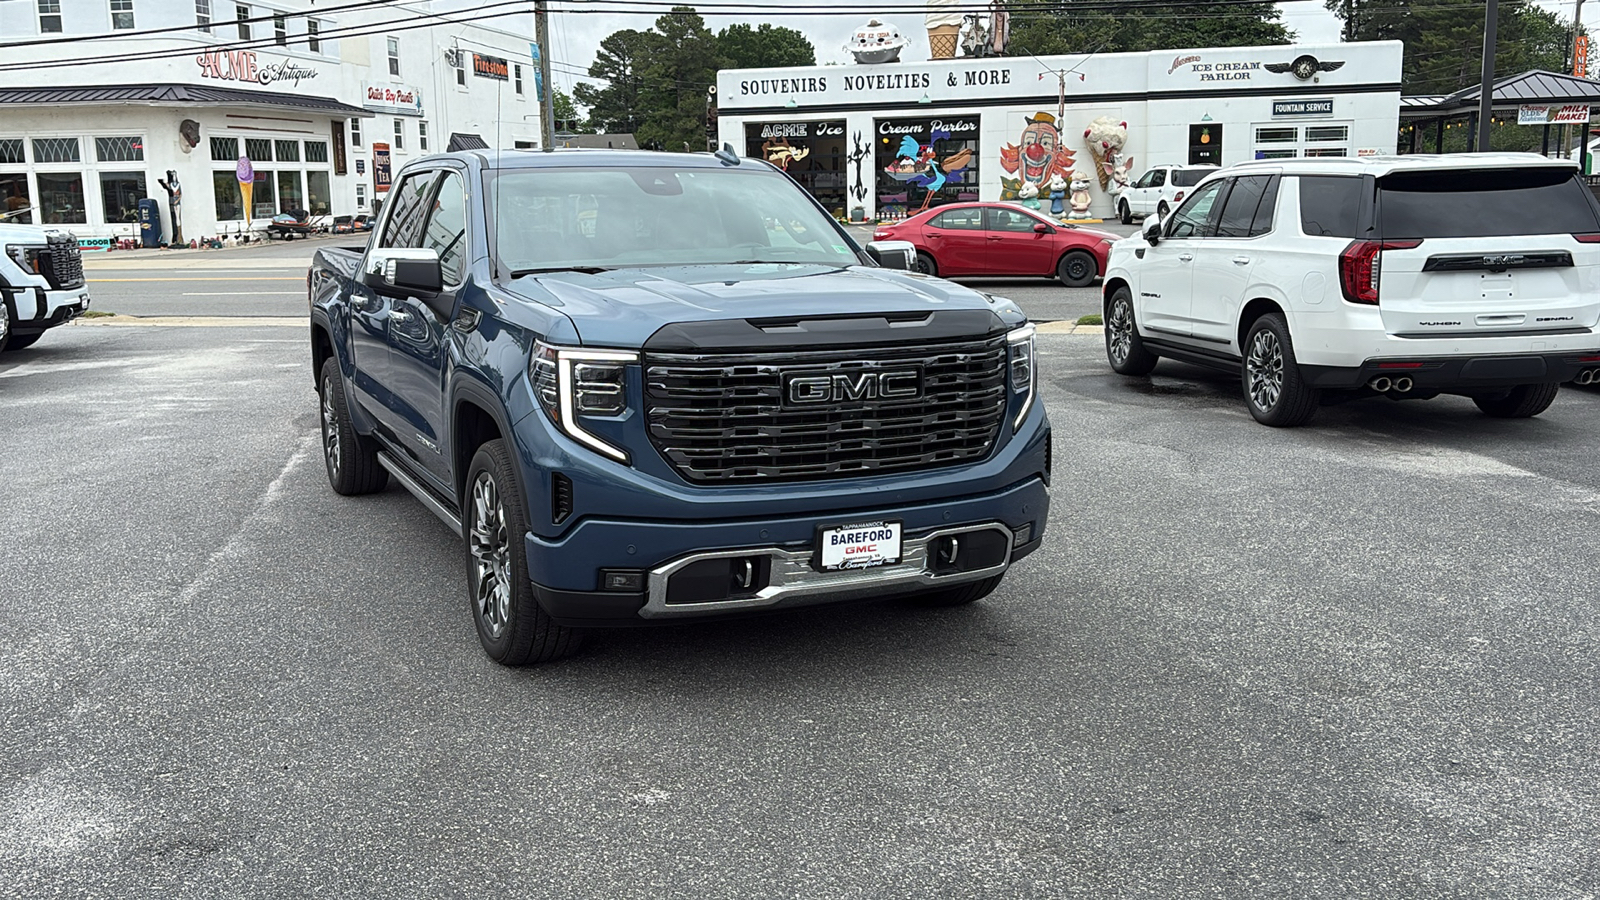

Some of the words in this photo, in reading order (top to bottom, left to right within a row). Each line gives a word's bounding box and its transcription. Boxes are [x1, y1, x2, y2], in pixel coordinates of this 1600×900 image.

[196, 47, 259, 83] ACME
[258, 57, 319, 88] Antiques
[473, 53, 508, 76] Firestone
[1191, 64, 1213, 72] ICE
[1215, 61, 1262, 72] CREAM
[741, 76, 828, 95] SOUVENIRS
[843, 72, 931, 91] NOVELTIES
[946, 71, 958, 87] &
[964, 69, 1012, 86] MORE
[1200, 72, 1252, 82] PARLOR
[1275, 104, 1305, 113] FOUNTAIN
[1306, 102, 1331, 112] SERVICE
[1553, 112, 1588, 121] SHAKES
[761, 123, 808, 138] ACME
[815, 122, 843, 136] Ice
[879, 121, 924, 135] Cream
[929, 119, 978, 133] Parlor
[377, 170, 390, 183] TEA
[1483, 255, 1524, 265] GMC
[789, 371, 918, 403] GMC
[842, 522, 884, 530] TAPPAHANNOCK
[831, 529, 893, 546] BAREFORD
[845, 544, 877, 554] GMC
